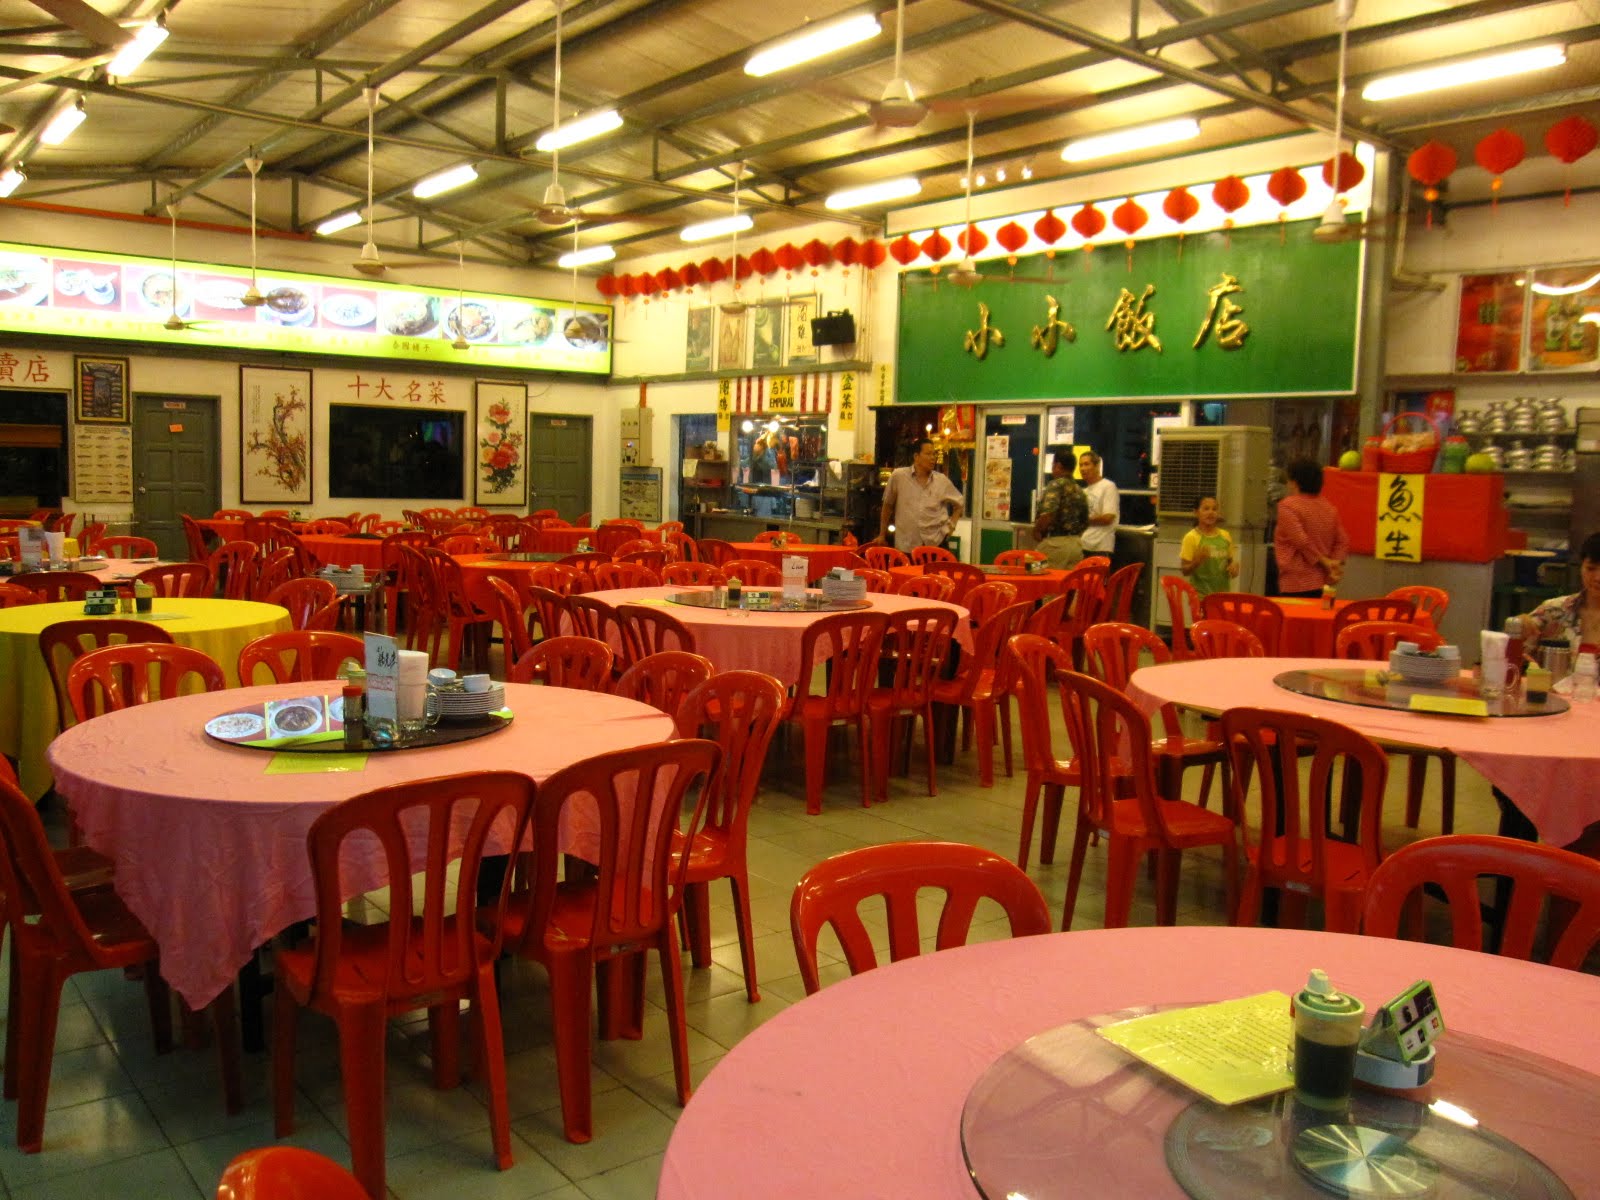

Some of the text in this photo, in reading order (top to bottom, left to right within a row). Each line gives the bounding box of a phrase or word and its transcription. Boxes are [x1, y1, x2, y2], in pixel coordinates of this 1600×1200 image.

[965, 271, 1249, 361] 小小飯店
[348, 374, 446, 405] 十大名菜
[1379, 474, 1423, 559] 魚生
